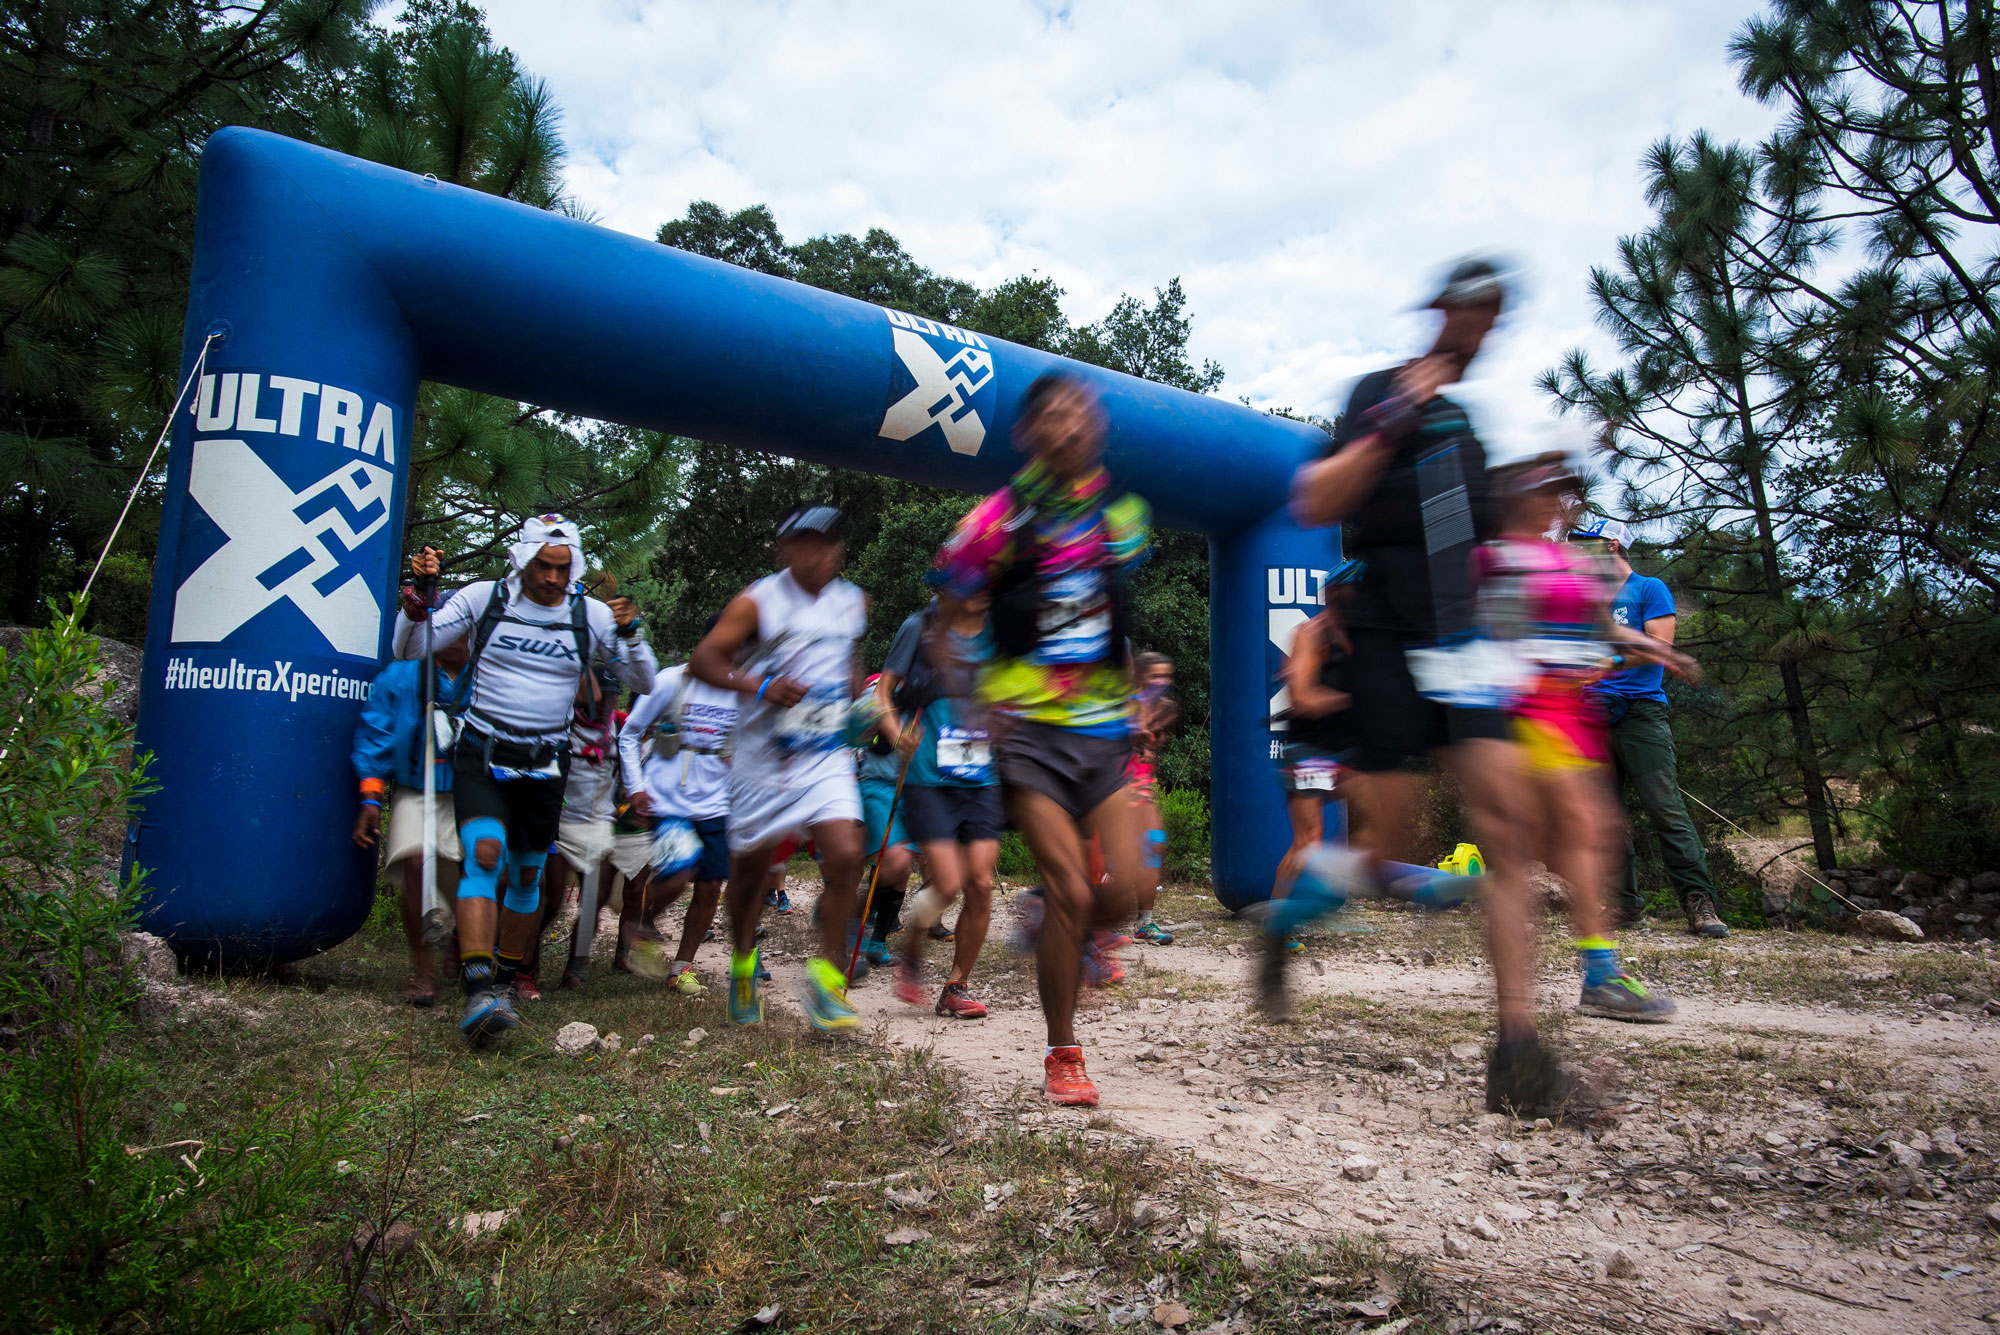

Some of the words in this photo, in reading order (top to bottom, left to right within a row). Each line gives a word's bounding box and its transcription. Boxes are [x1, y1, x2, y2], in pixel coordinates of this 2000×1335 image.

[883, 308, 988, 350] ULTRA
[197, 373, 395, 466] ULTRA
[1268, 568, 1326, 606] ULT
